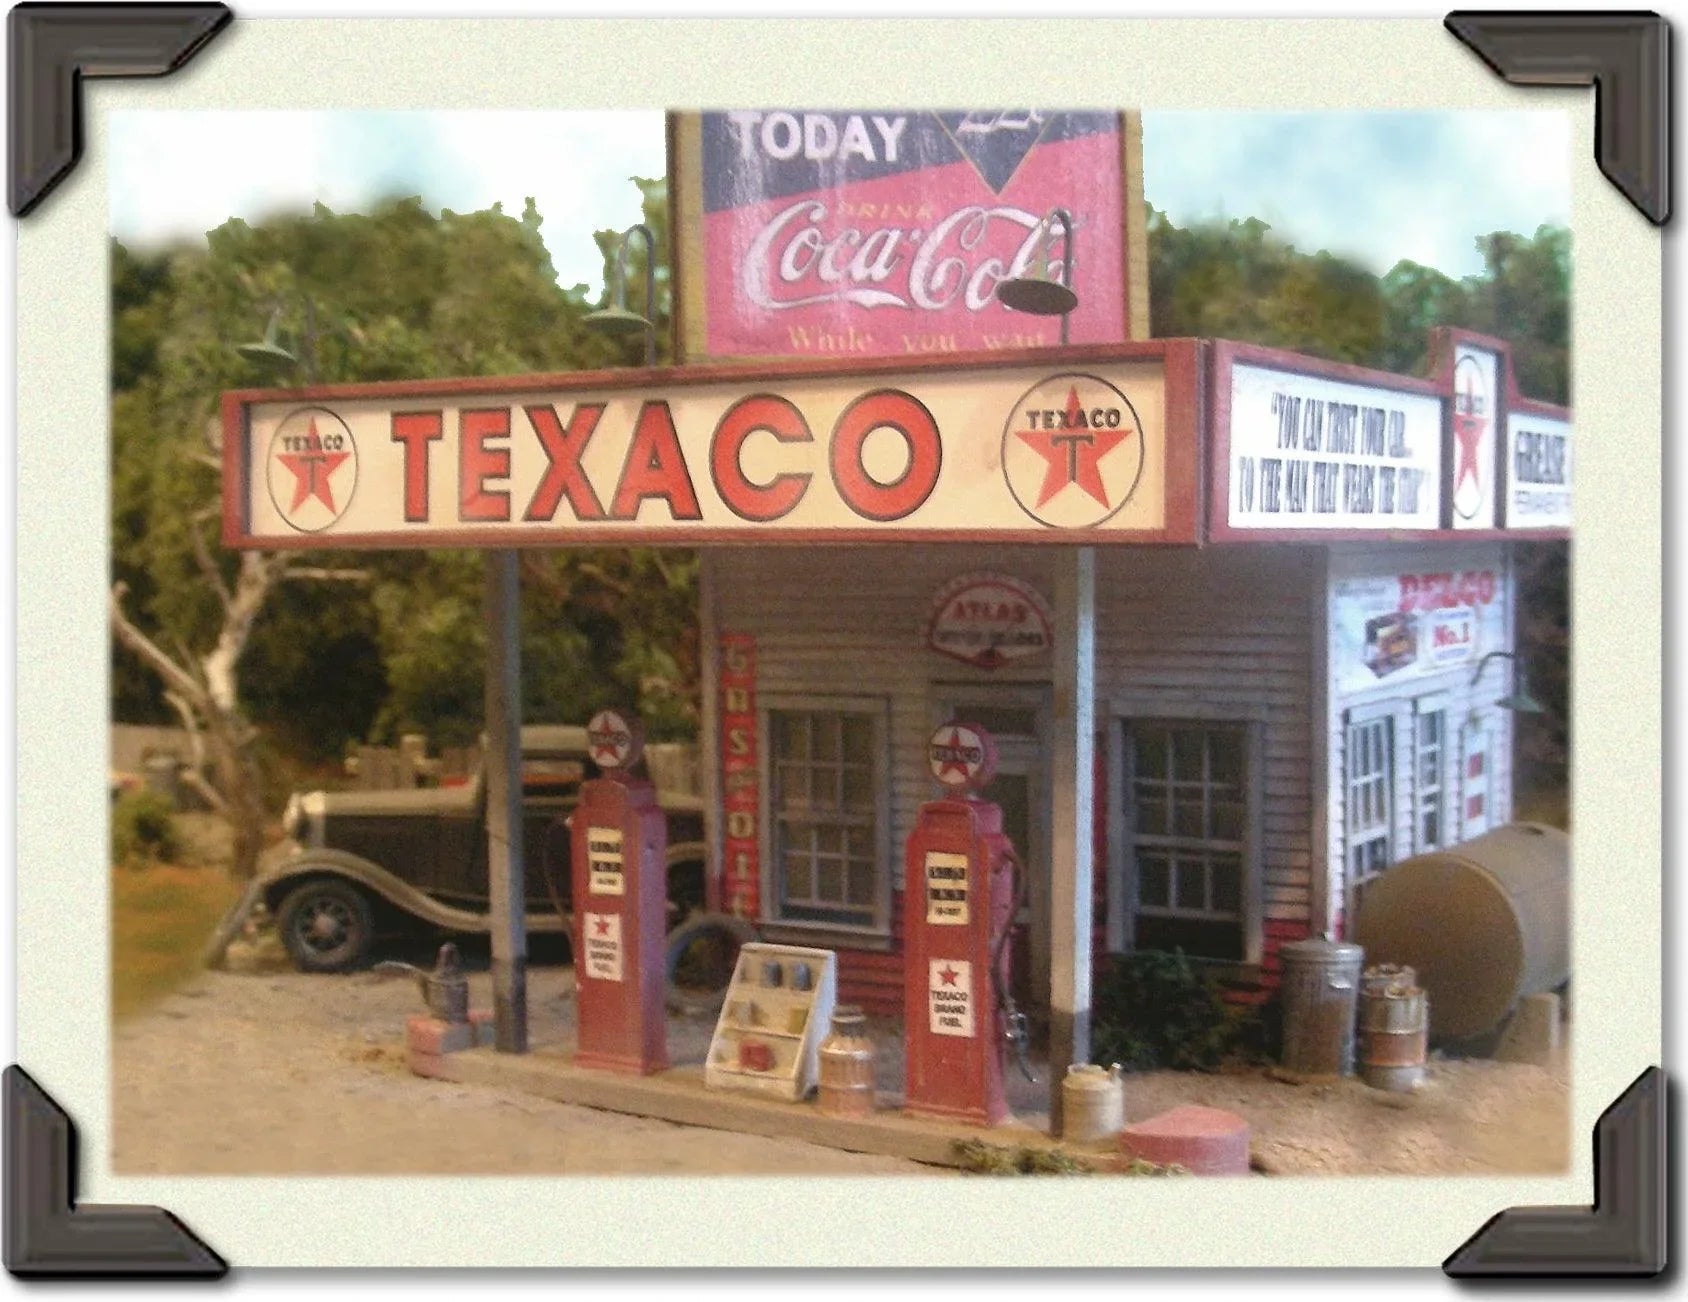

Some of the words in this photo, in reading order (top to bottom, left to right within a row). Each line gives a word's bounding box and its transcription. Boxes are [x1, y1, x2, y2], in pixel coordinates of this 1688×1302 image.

[730, 112, 907, 162] TODAY
[838, 201, 933, 219] DRINK
[902, 333, 957, 352] you
[1026, 408, 1121, 431] TEXACO
[282, 434, 344, 452] TEXACO
[390, 387, 943, 523] TEXACO
